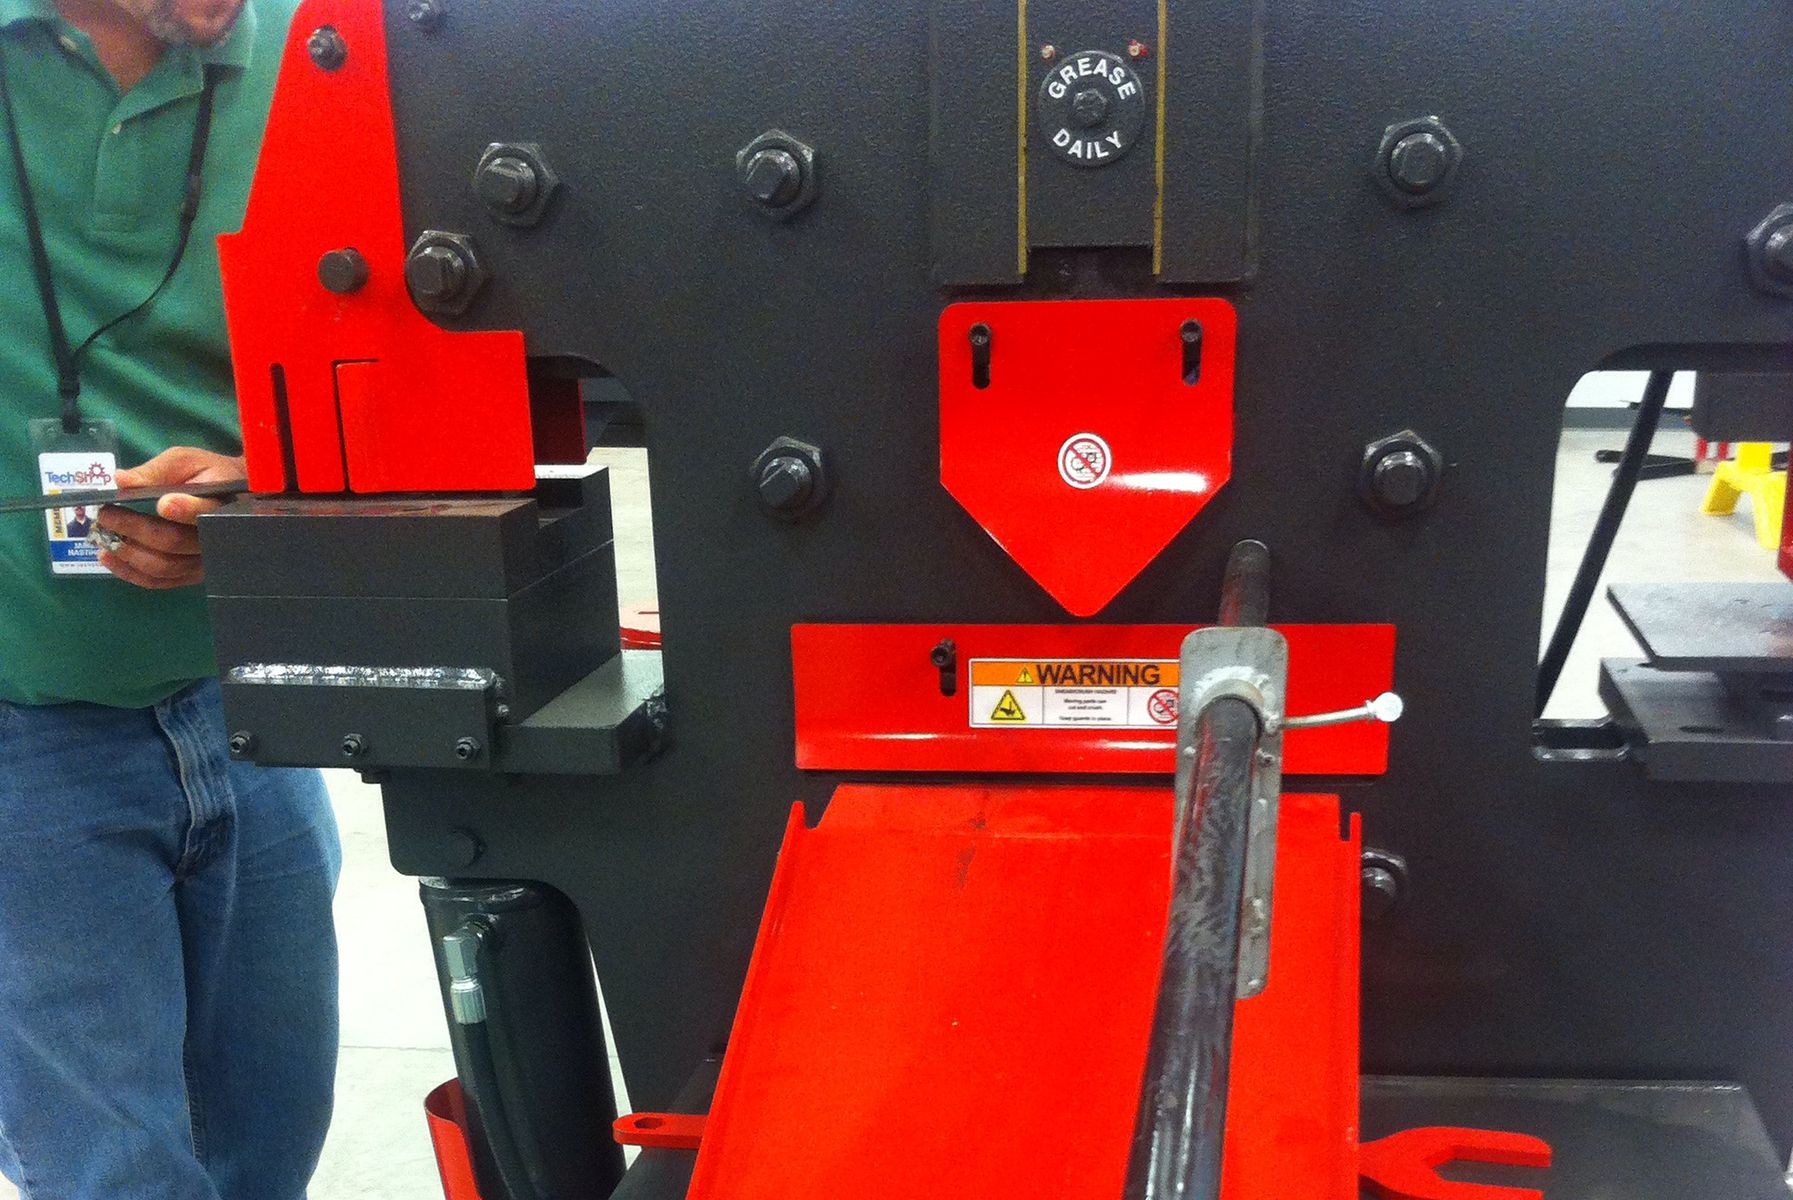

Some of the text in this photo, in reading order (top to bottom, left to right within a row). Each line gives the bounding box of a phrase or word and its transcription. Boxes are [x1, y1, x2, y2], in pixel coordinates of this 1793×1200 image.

[1048, 57, 1136, 100] GREASE
[1052, 128, 1122, 159] DAILY
[1036, 663, 1161, 685] WARNING
